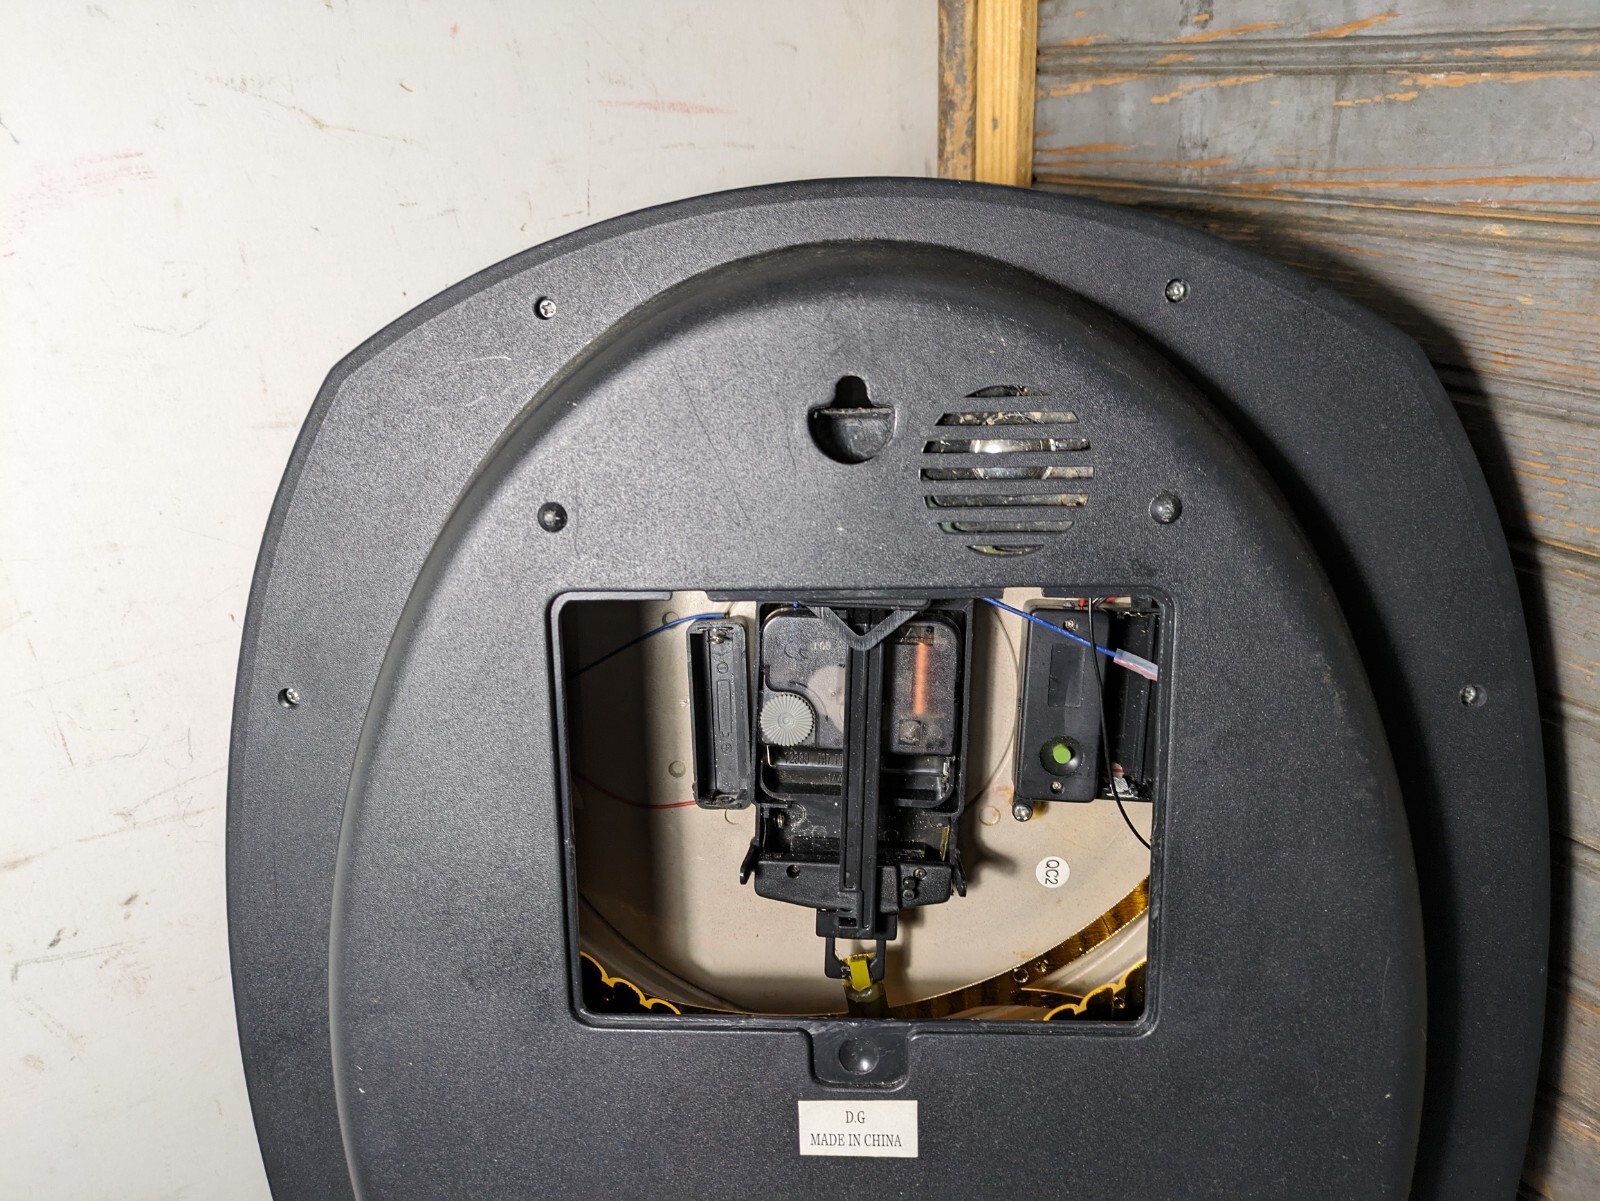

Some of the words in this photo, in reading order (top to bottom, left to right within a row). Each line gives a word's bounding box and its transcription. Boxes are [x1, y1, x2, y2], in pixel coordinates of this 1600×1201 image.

[1044, 859, 1060, 885] QC2
[845, 1110, 866, 1124] D.G
[810, 1133, 846, 1147] MADE
[848, 1133, 861, 1147] IN
[864, 1133, 902, 1147] CHINA
